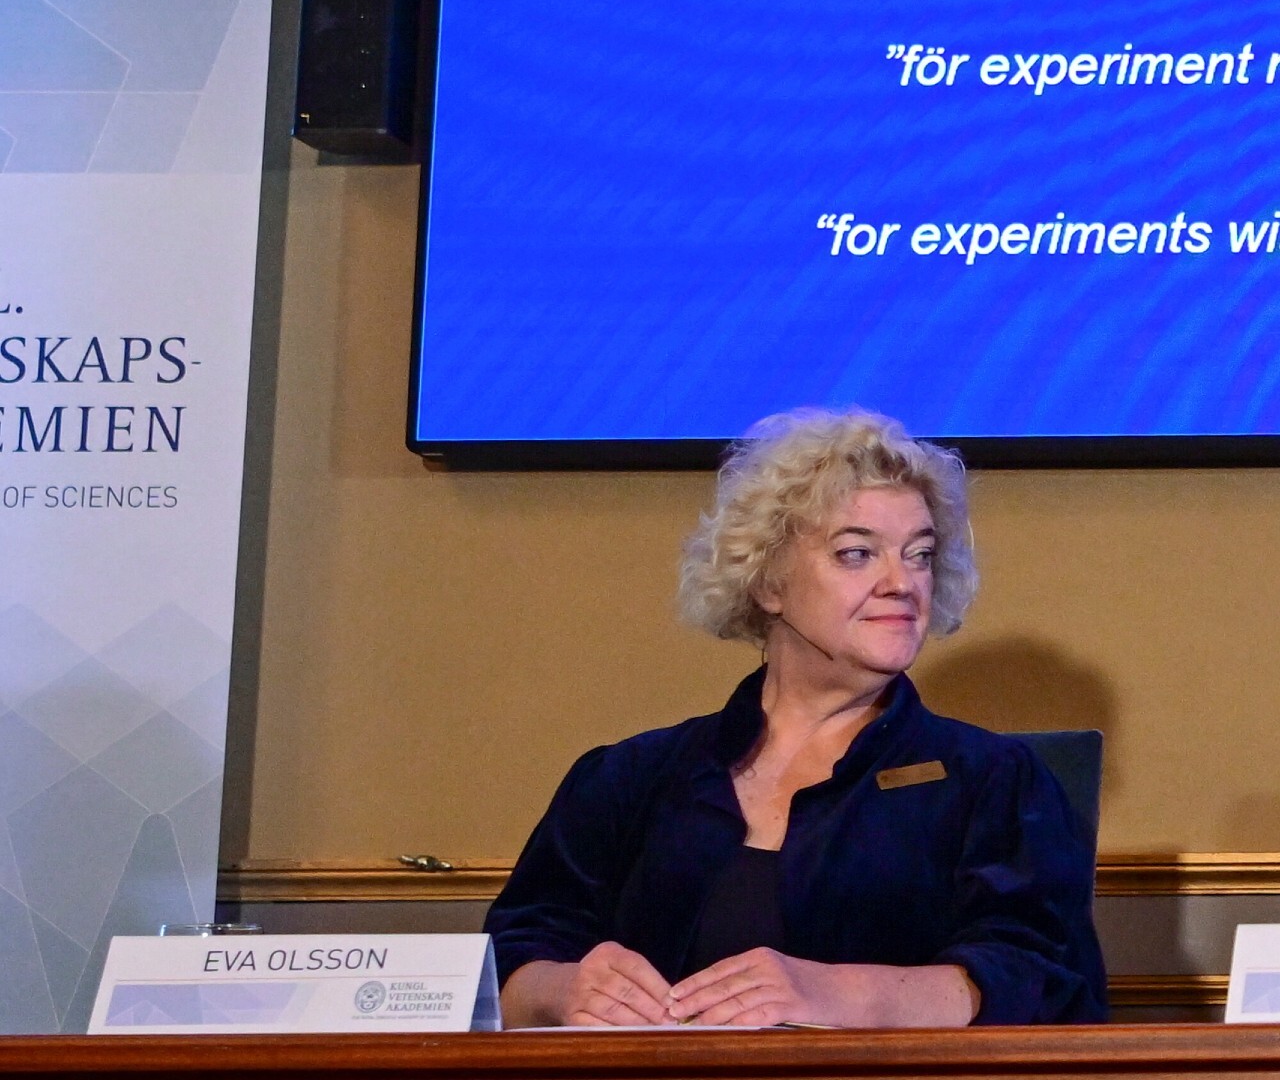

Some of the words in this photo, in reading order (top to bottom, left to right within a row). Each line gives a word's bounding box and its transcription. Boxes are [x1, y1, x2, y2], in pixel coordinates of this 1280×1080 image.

[886, 44, 971, 86] ”för
[980, 43, 1255, 96] experiment
[816, 213, 902, 256] “for
[911, 212, 1213, 265] experiments
[0, 406, 187, 453] MIEN
[2, 485, 37, 509] OF
[44, 485, 178, 509] SCIENCES
[203, 950, 256, 972] EVA
[267, 948, 388, 971] OLSSON
